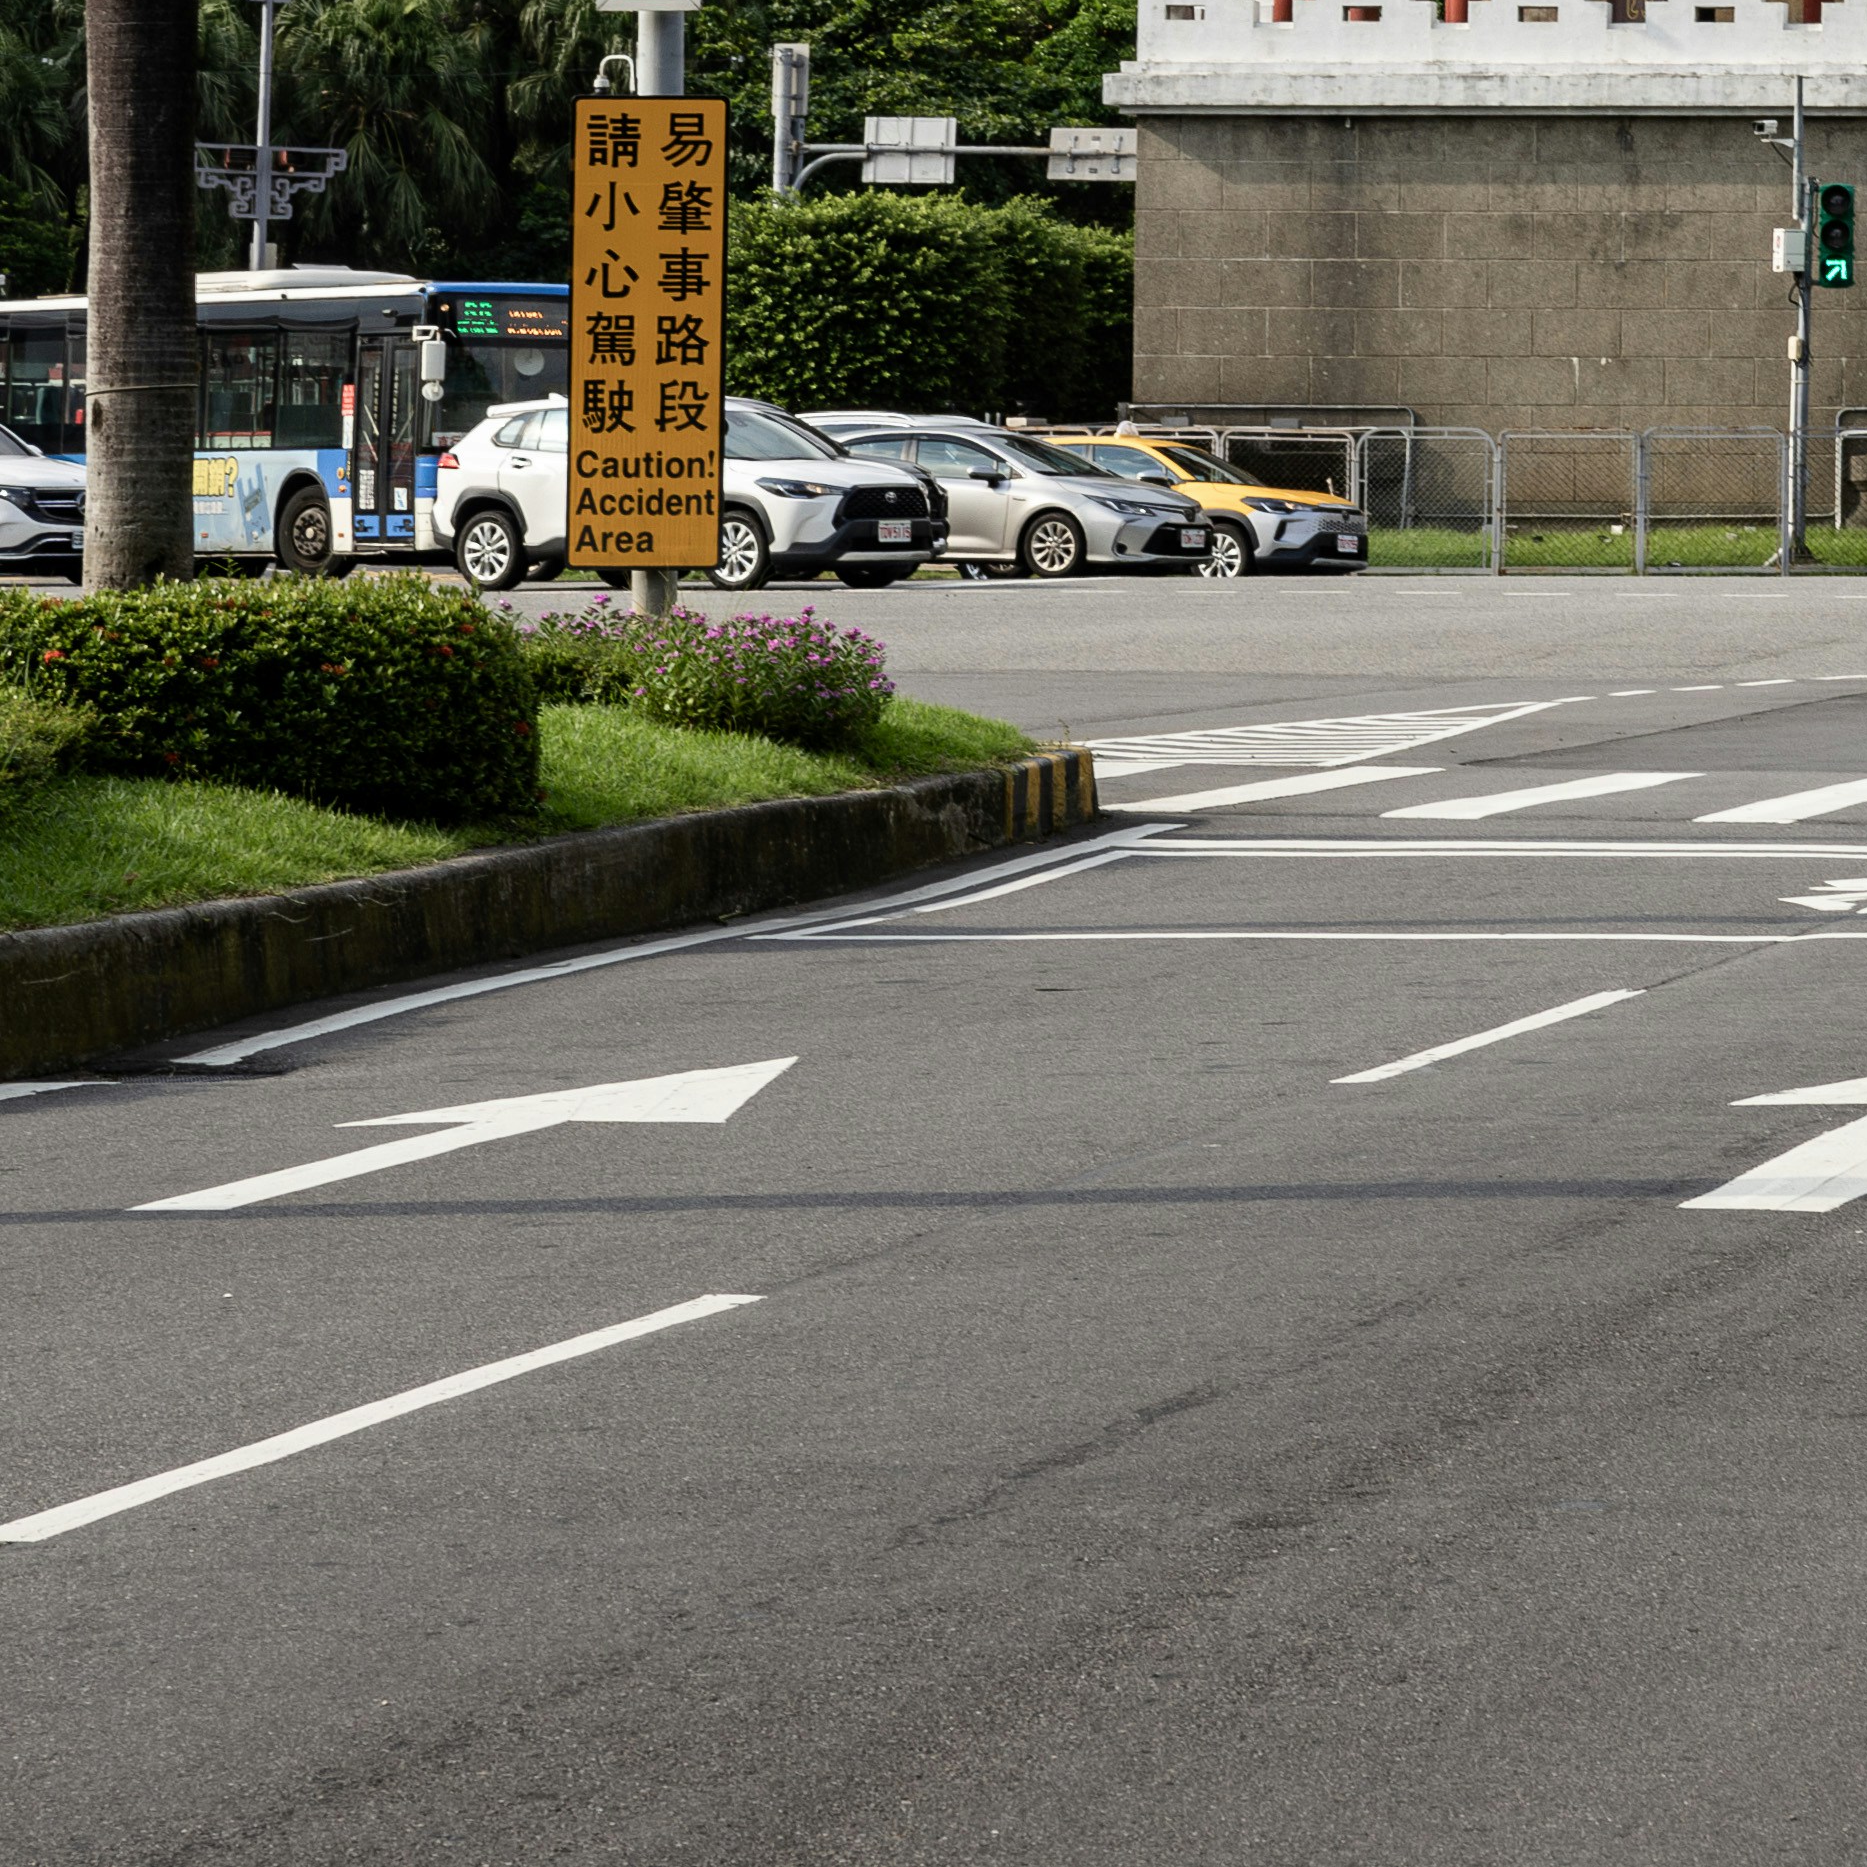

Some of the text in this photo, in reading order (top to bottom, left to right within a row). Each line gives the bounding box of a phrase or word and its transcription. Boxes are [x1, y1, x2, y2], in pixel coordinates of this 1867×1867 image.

[582, 112, 642, 435] 請小心駕駛
[655, 112, 714, 432] 易肇事路段
[576, 449, 716, 479] Caution!
[575, 487, 716, 516] Accident
[574, 525, 654, 553] Area
